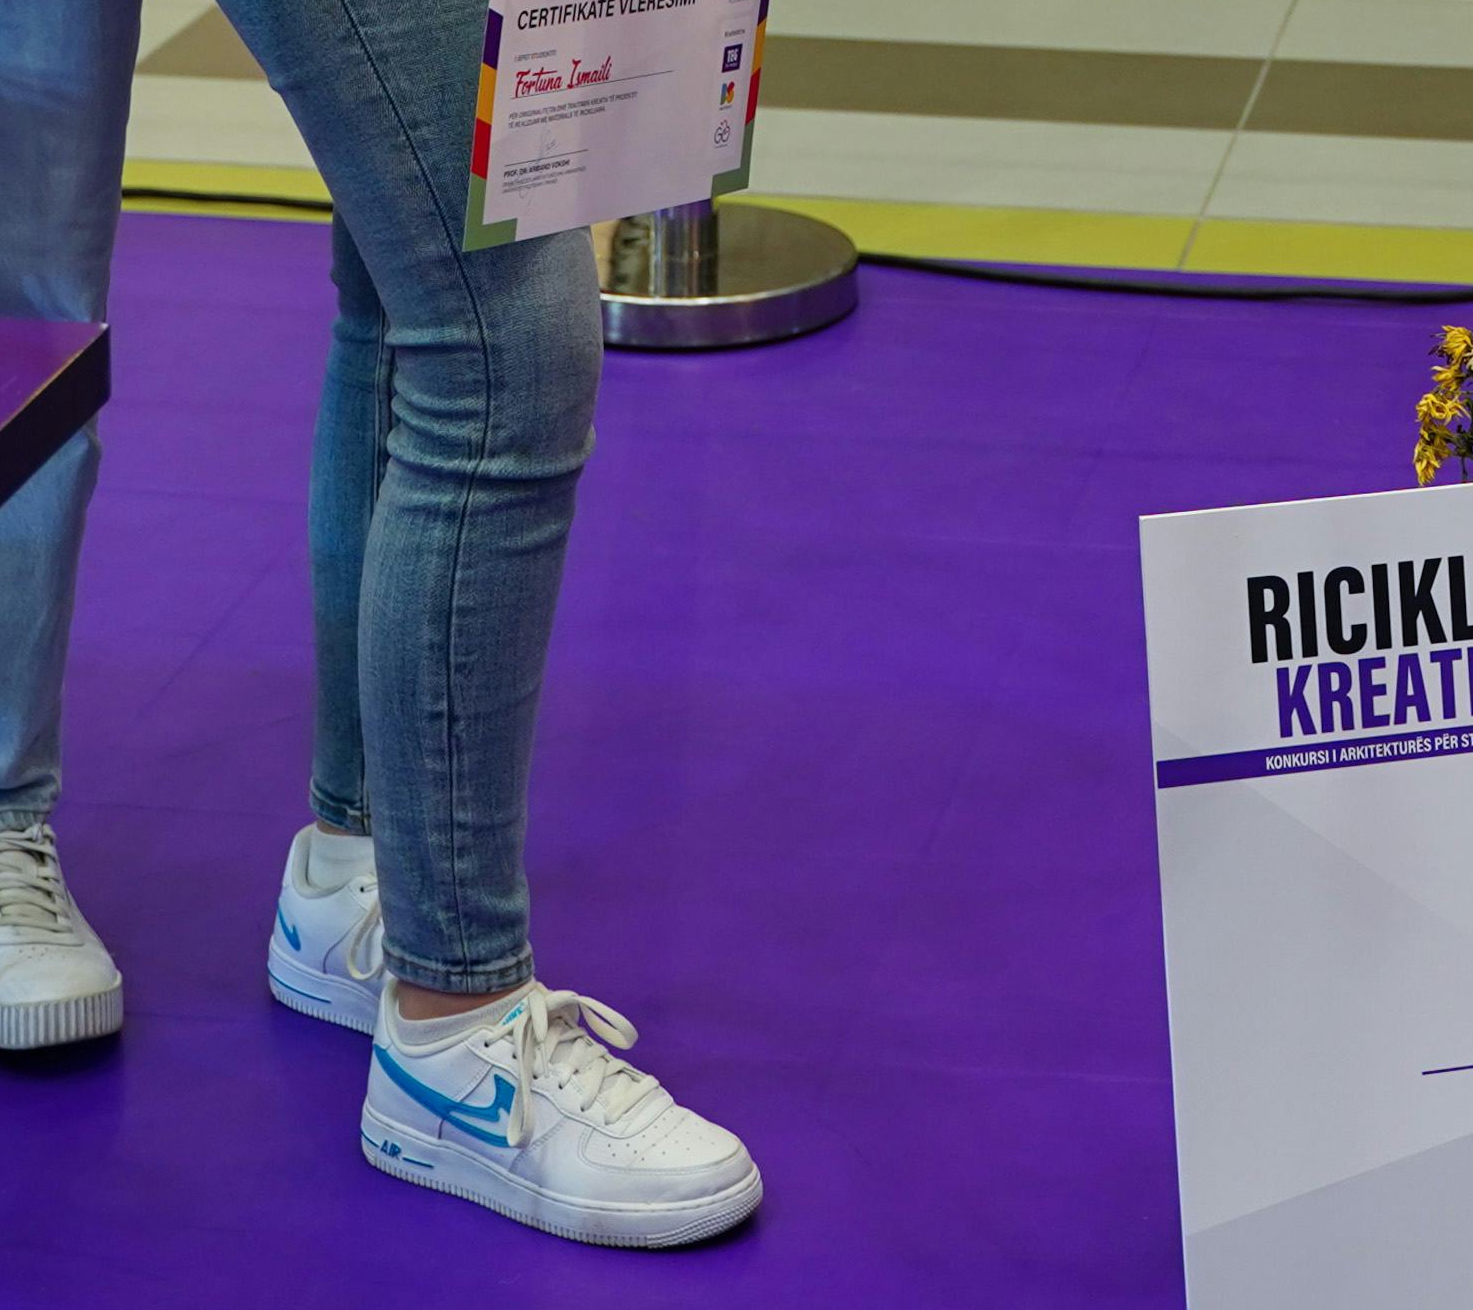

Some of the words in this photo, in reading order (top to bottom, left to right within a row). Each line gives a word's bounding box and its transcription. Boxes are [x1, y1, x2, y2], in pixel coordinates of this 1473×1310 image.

[515, 67, 563, 98] Fortuna
[567, 55, 613, 90] Ismaili
[1266, 749, 1330, 770] KONKURSI
[1332, 749, 1337, 762] I
[1339, 736, 1432, 762] ARKITEKTURËS
[1434, 732, 1459, 751] PËR
